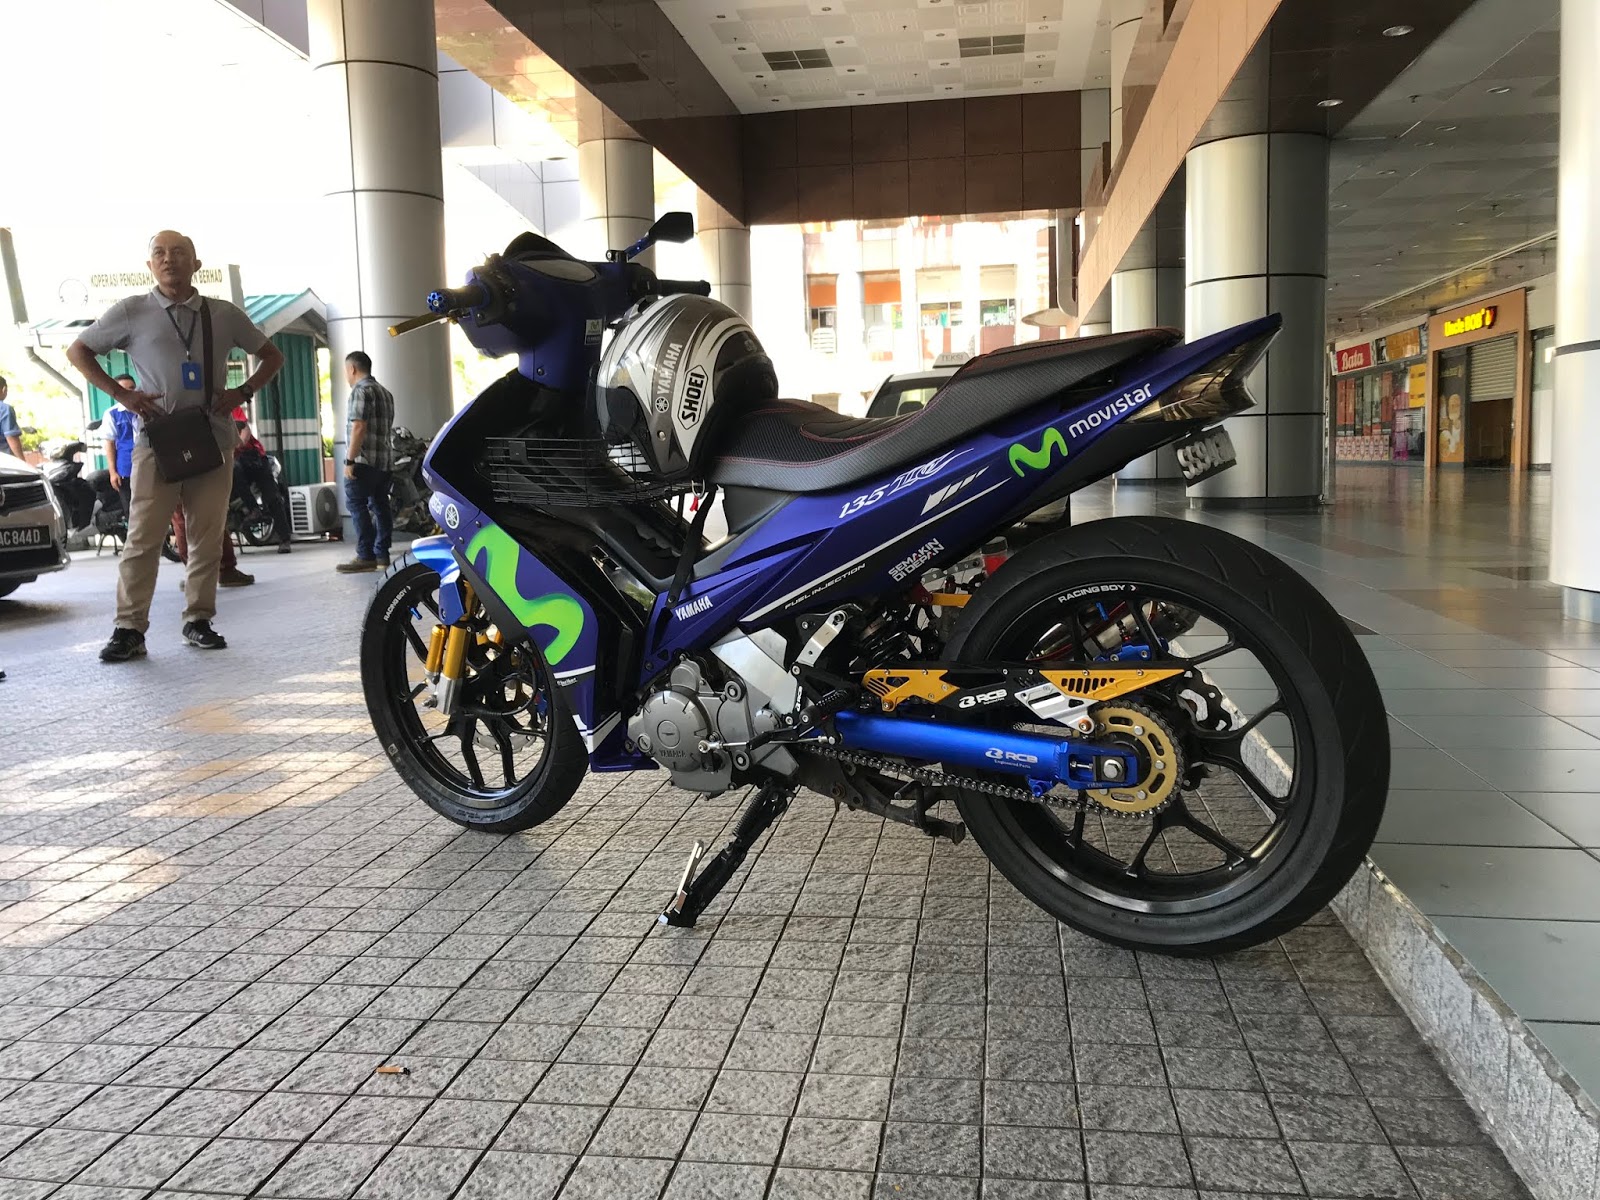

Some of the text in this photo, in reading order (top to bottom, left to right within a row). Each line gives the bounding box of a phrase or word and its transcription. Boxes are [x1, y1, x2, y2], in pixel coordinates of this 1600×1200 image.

[90, 274, 118, 287] KOPERASI
[199, 269, 223, 283] BERHAD
[657, 342, 683, 395] YAMAHA
[1341, 349, 1365, 371] Bata
[681, 372, 705, 422] SHOEI
[1068, 383, 1153, 438] movistar
[838, 484, 890, 518] 135
[888, 538, 940, 577] SEMAKIN
[892, 544, 945, 582] DI DEPAN
[785, 562, 866, 610] FUEL INJECTION
[1057, 584, 1126, 604] RACING BOY
[383, 588, 408, 621] RACING BOY
[675, 595, 714, 621] YAMAHA
[976, 689, 1007, 703] RCB
[993, 759, 1018, 768] Engineered
[1005, 751, 1038, 763] RCB
